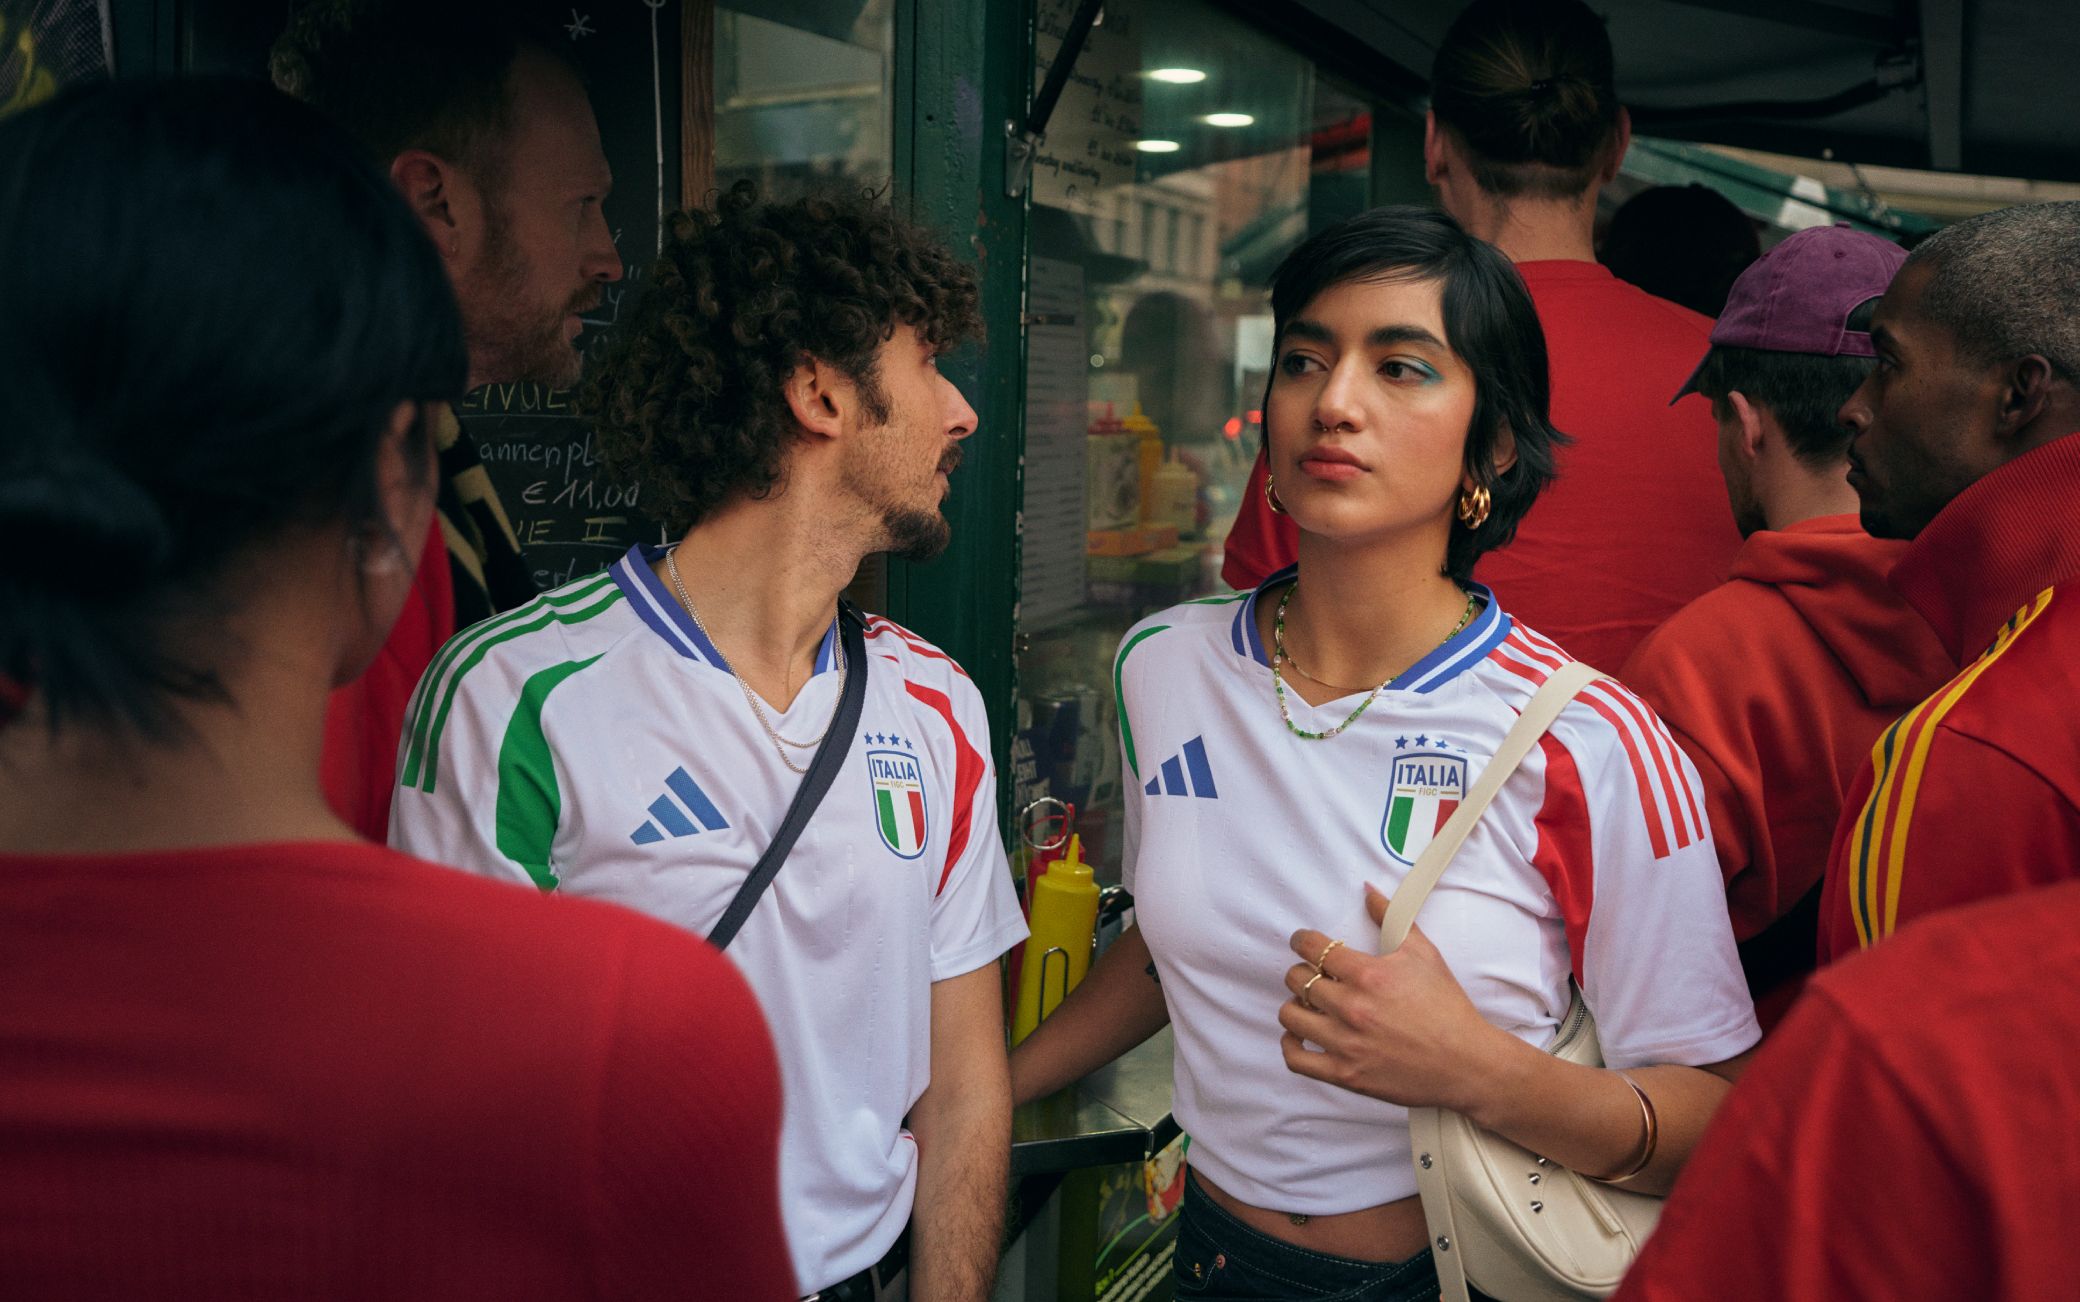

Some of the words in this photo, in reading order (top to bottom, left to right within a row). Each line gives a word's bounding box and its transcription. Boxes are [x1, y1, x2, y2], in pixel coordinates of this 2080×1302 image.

[479, 432, 601, 485] annenpl
[872, 758, 918, 781] ITALIA
[1397, 763, 1460, 787] ITALIA
[1418, 787, 1438, 797] FIGC
